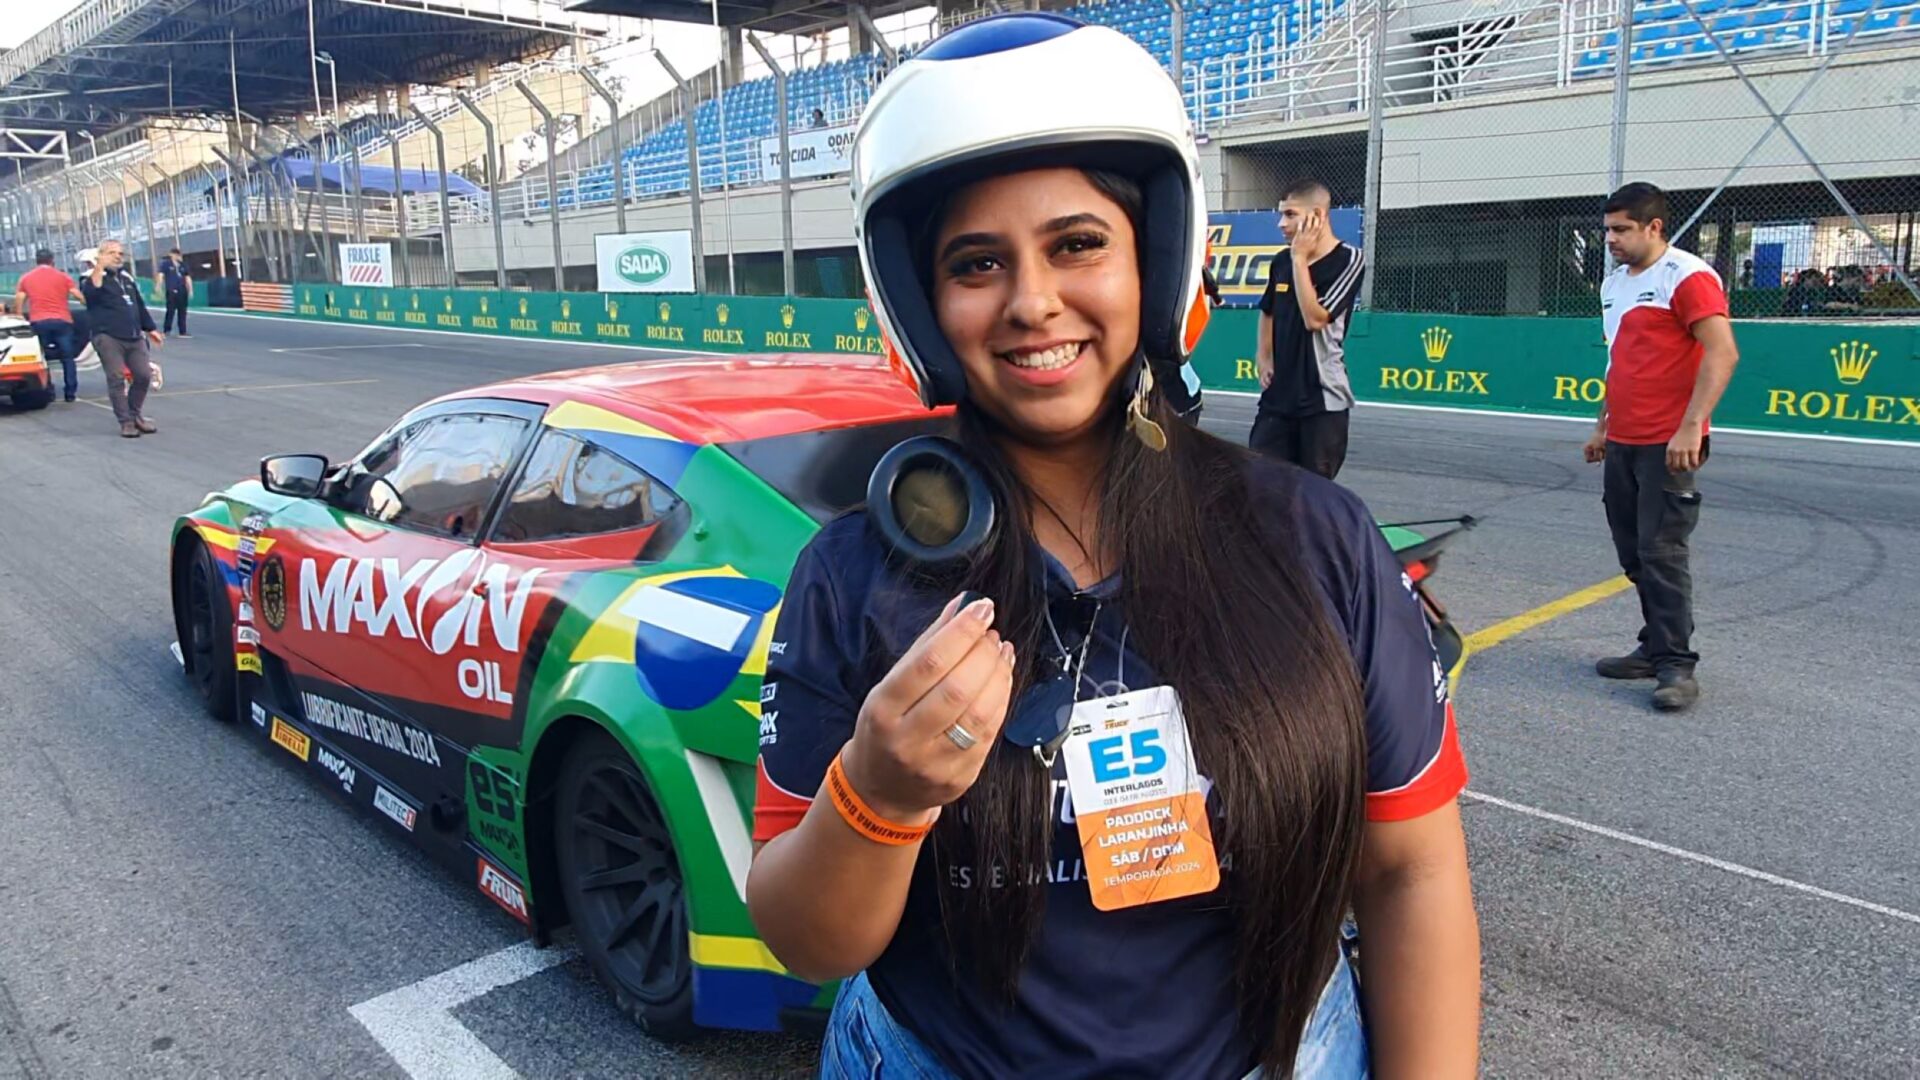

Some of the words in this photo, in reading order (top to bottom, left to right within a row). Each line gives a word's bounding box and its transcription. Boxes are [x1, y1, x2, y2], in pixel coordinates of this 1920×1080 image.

[769, 146, 816, 166] TOCIDA
[621, 253, 663, 275] SADA
[472, 315, 498, 329] ROLEX
[510, 317, 538, 331] ROLEX
[551, 320, 583, 335] ROLEX
[597, 322, 630, 338] ROLEX
[647, 324, 684, 341] ROLEX
[703, 329, 744, 345] ROLEX
[765, 331, 811, 348] ROLEX
[1379, 367, 1489, 395] ROLEX
[300, 548, 548, 655] MAXON
[457, 658, 514, 704] OIL
[275, 719, 305, 753] PIRELLI
[301, 690, 371, 740] LUBRIFICANTE
[366, 712, 411, 756] OFICIAL
[404, 726, 441, 767] 2024
[317, 746, 356, 786] MAXON
[1088, 728, 1167, 783] E5
[1104, 778, 1164, 796] INTERLAGOS
[1105, 806, 1172, 829] PADDOCK
[1098, 820, 1189, 848] LARANJINHA
[1110, 850, 1140, 867] SÁB
[1142, 847, 1149, 863] /
[1151, 841, 1185, 860] DOM
[1103, 864, 1175, 887] TEMPORADA
[1174, 861, 1201, 873] 2024
